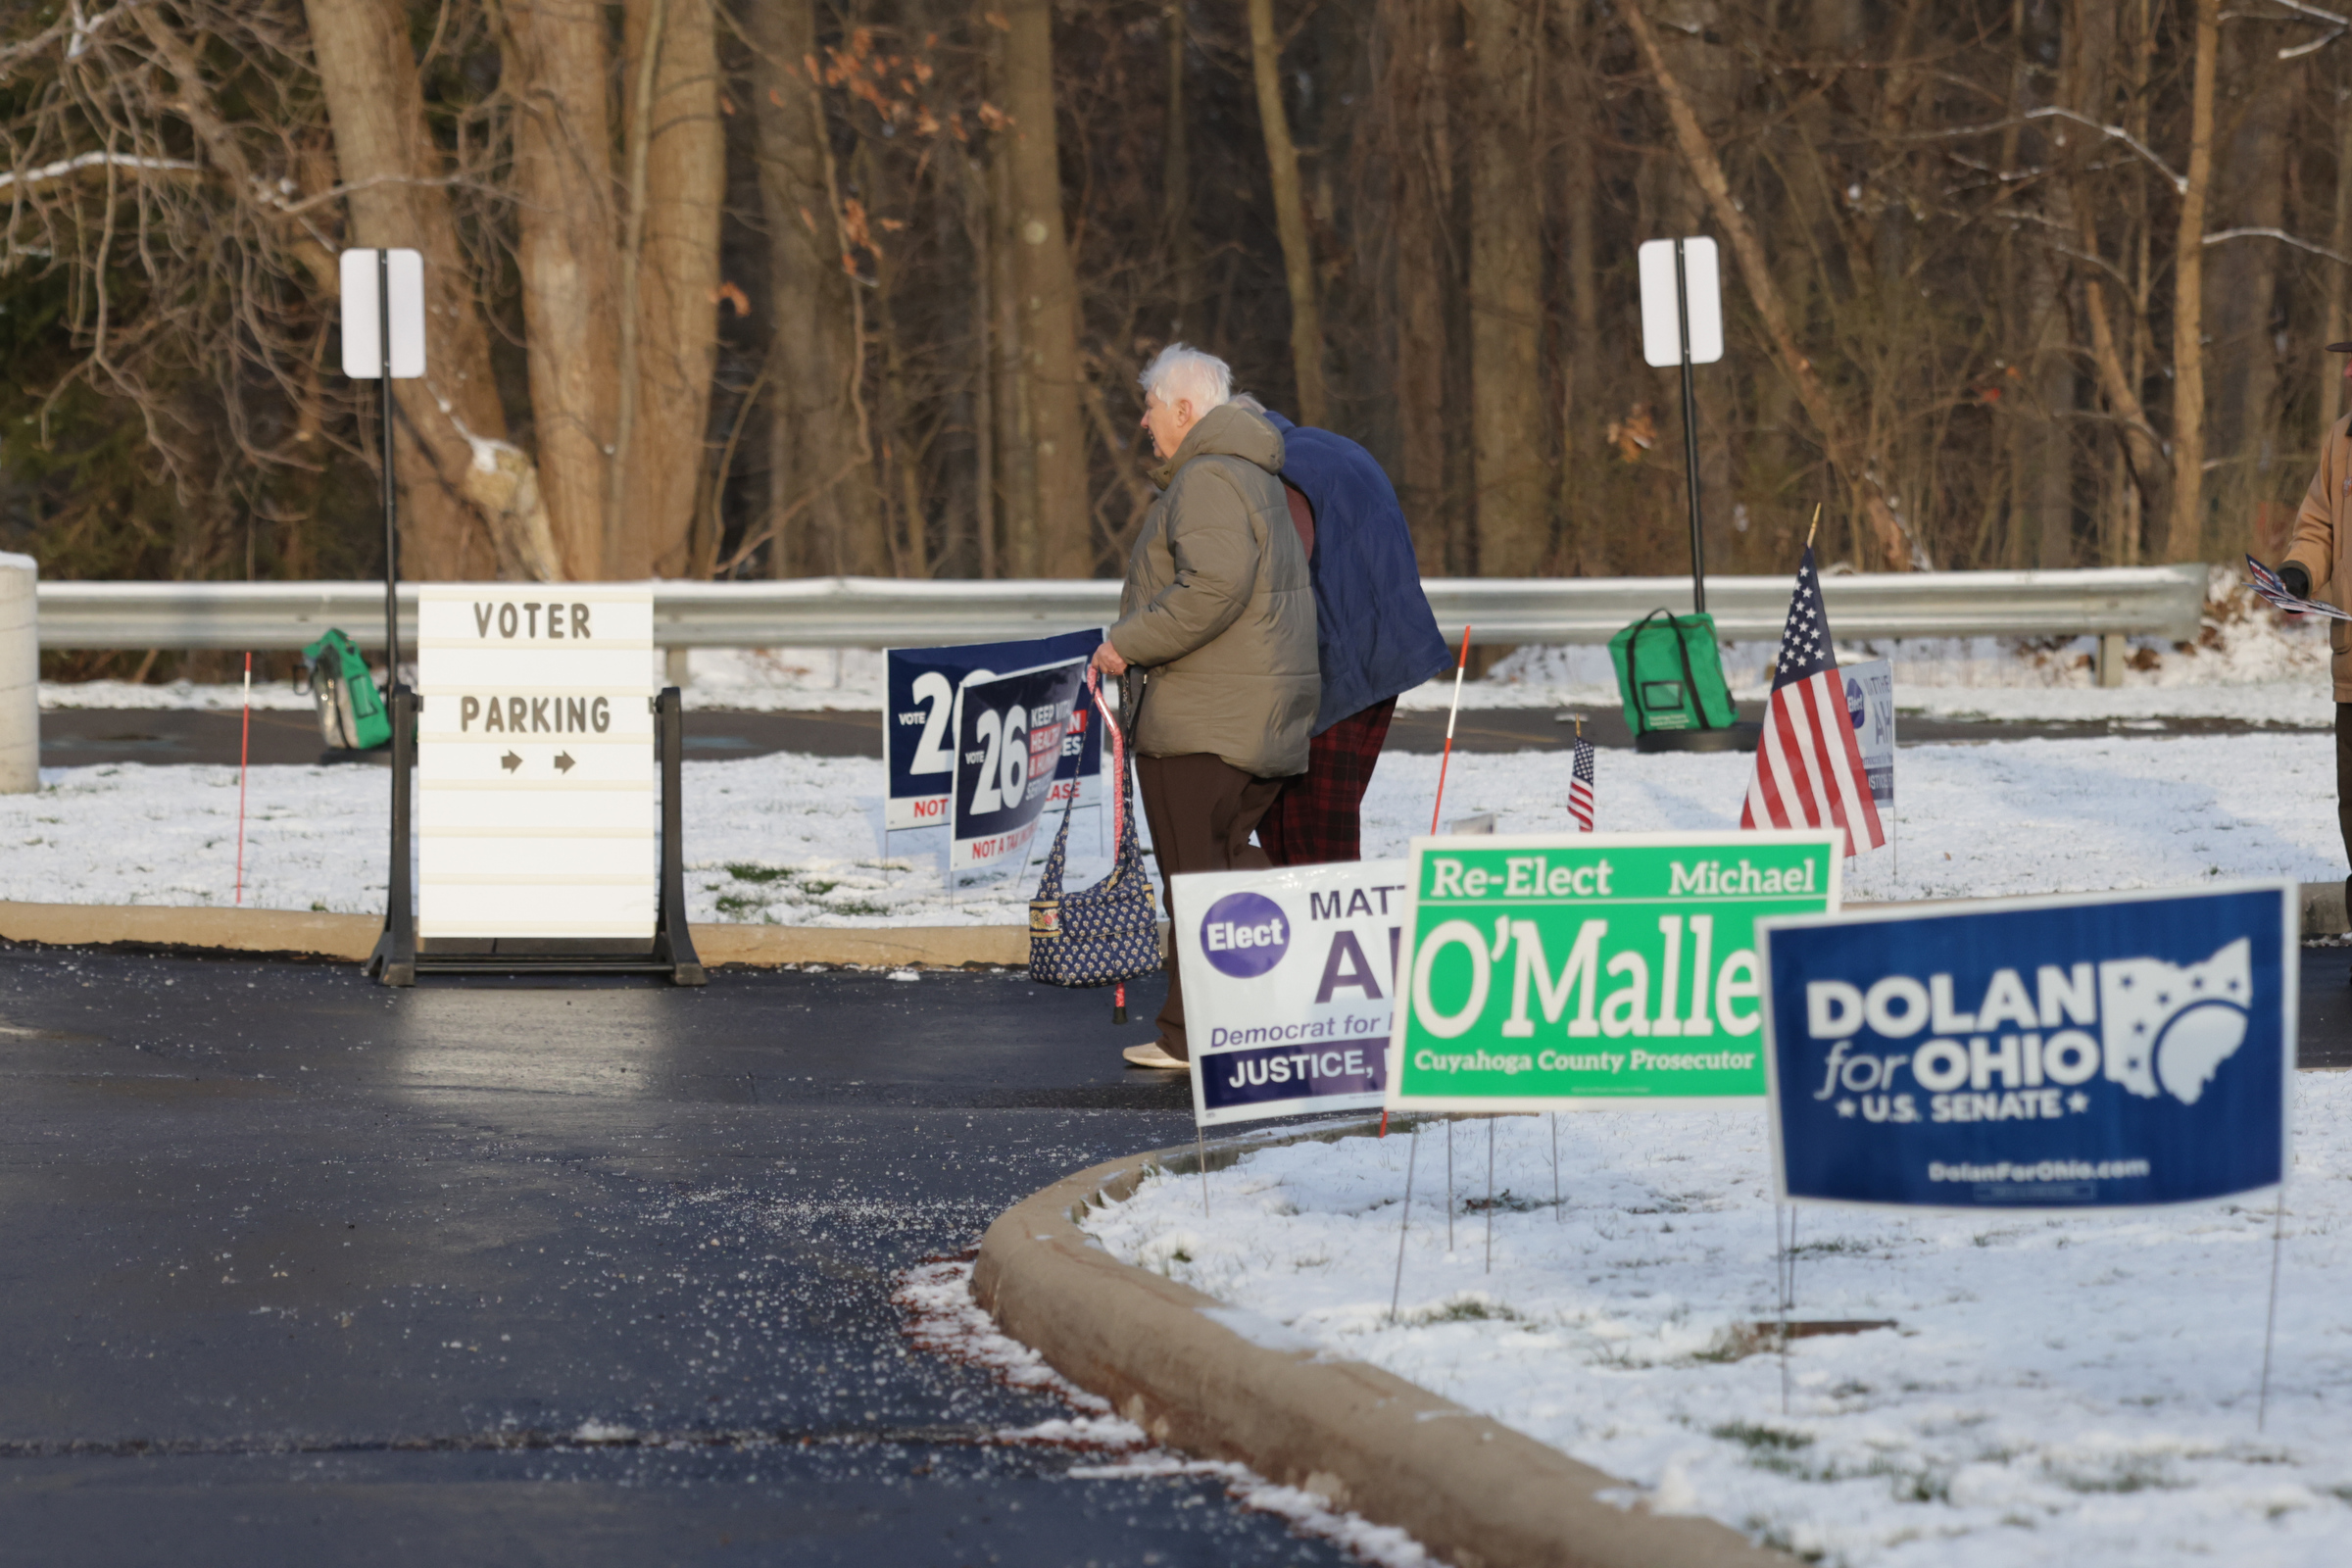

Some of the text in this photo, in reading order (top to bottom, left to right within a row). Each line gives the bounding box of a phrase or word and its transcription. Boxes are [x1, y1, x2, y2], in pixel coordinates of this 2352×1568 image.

[474, 602, 591, 639] VOTER
[461, 696, 611, 733] PARKING
[899, 711, 926, 725] VOTE
[1847, 695, 1864, 713] Elect
[965, 750, 985, 764] VOTE
[969, 705, 1028, 815] 26
[913, 799, 949, 817] NOT
[972, 840, 997, 859] NOT
[998, 837, 1004, 855] A
[1430, 856, 1614, 898] Re-Elect
[1668, 858, 1816, 896] Michael
[1310, 884, 1405, 920] MAT
[1206, 918, 1284, 951] Elect
[1806, 962, 2097, 1039] DOLAN
[1210, 1016, 1335, 1048] Democrat
[1344, 1013, 1382, 1035] for
[1229, 1050, 1374, 1088] JUSTICE,
[1414, 1049, 1533, 1075] Cuyahoga
[1538, 1050, 1624, 1074] County
[1629, 1049, 1756, 1071] Prosecutor
[1813, 1029, 2100, 1101] for OHIO
[1861, 1088, 2063, 1123] U.S. SENATE
